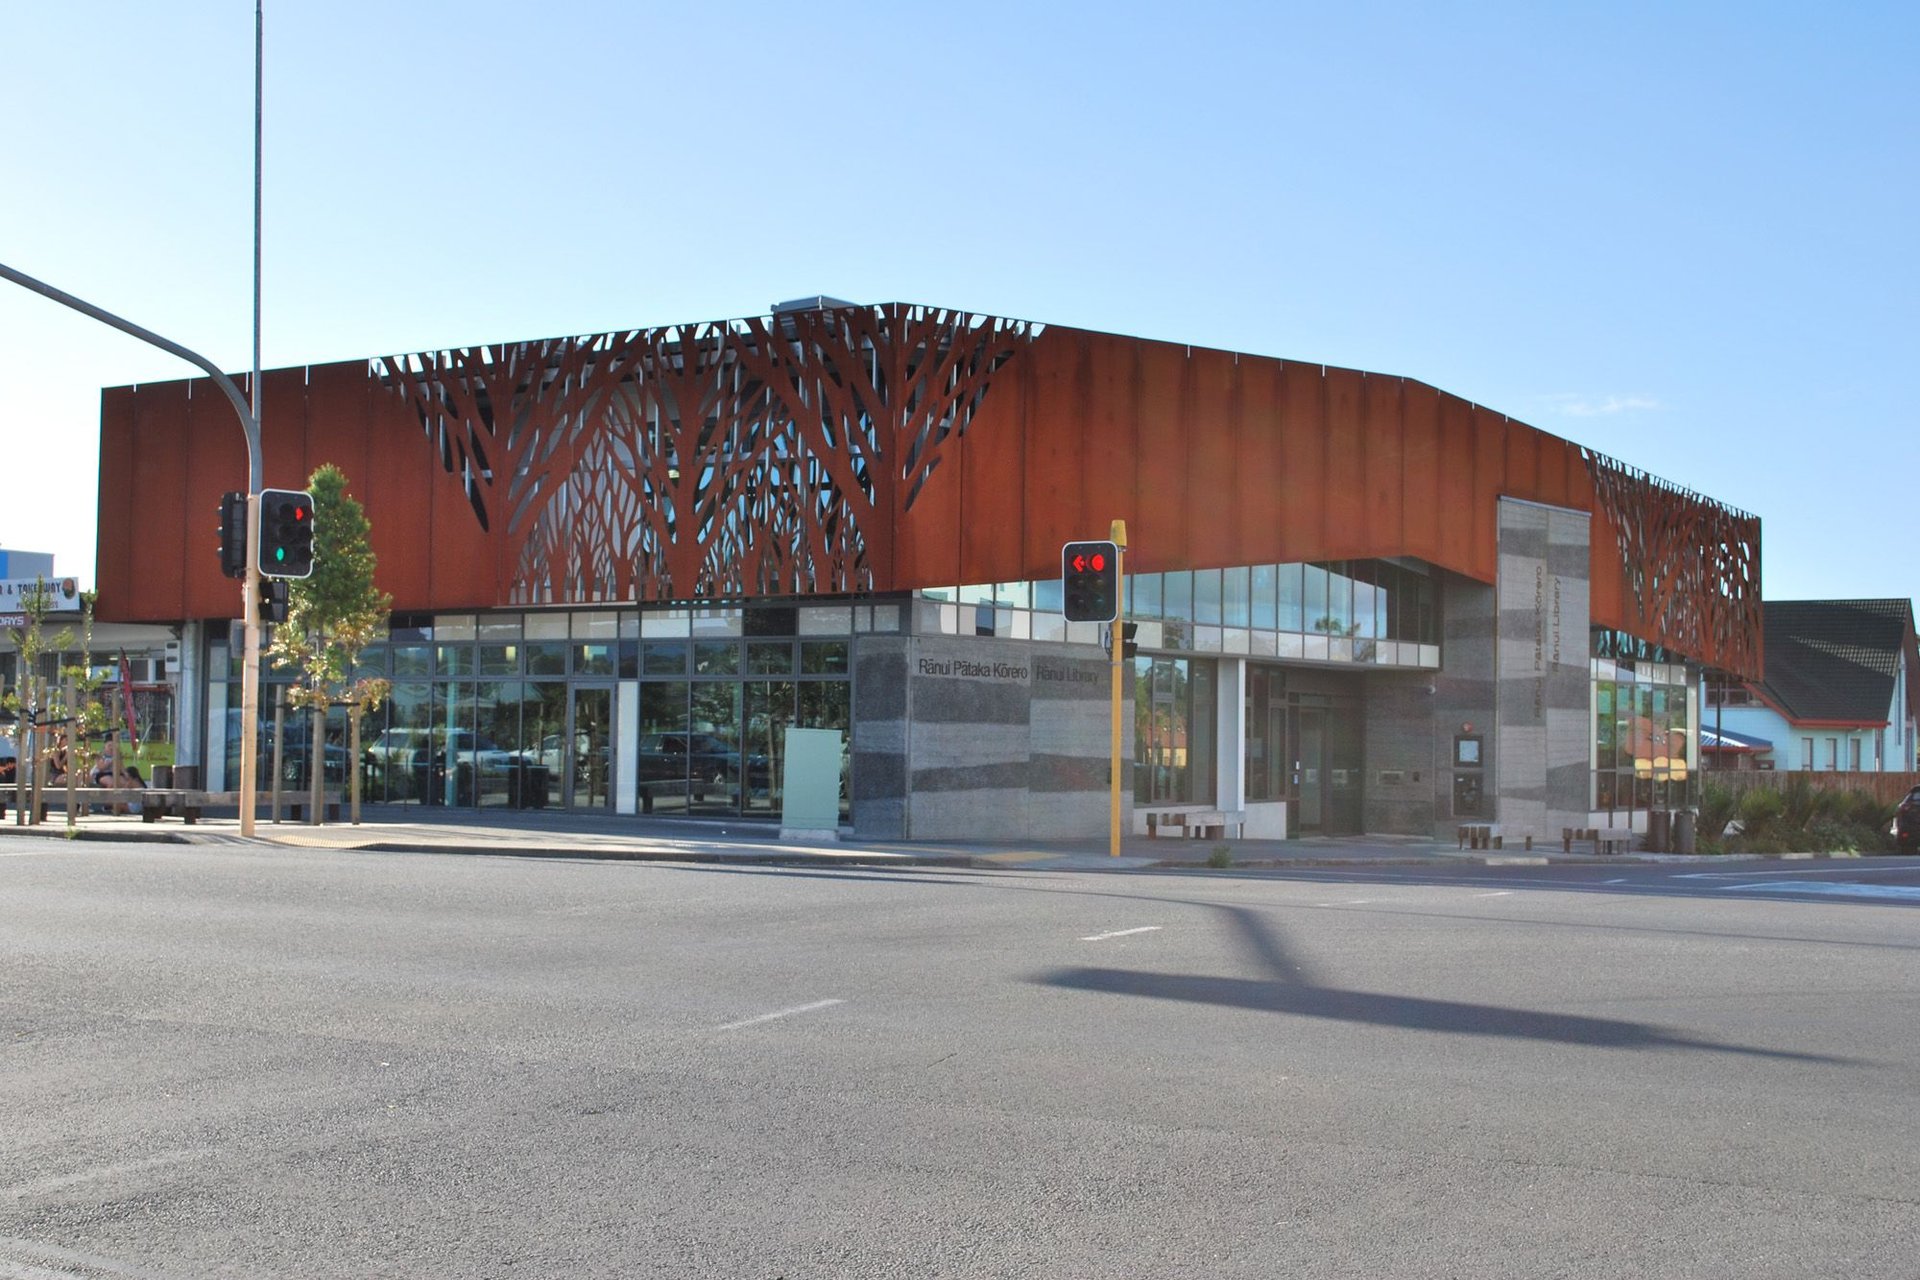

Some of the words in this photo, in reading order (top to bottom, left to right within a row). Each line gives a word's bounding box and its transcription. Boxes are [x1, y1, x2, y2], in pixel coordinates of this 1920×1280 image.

[1552, 577, 1561, 628] Library
[919, 658, 950, 676] Rānui
[953, 660, 990, 678] Pātaka
[993, 662, 1028, 680] Kōrero
[1036, 665, 1064, 681] Rānui
[1067, 667, 1098, 685] Library
